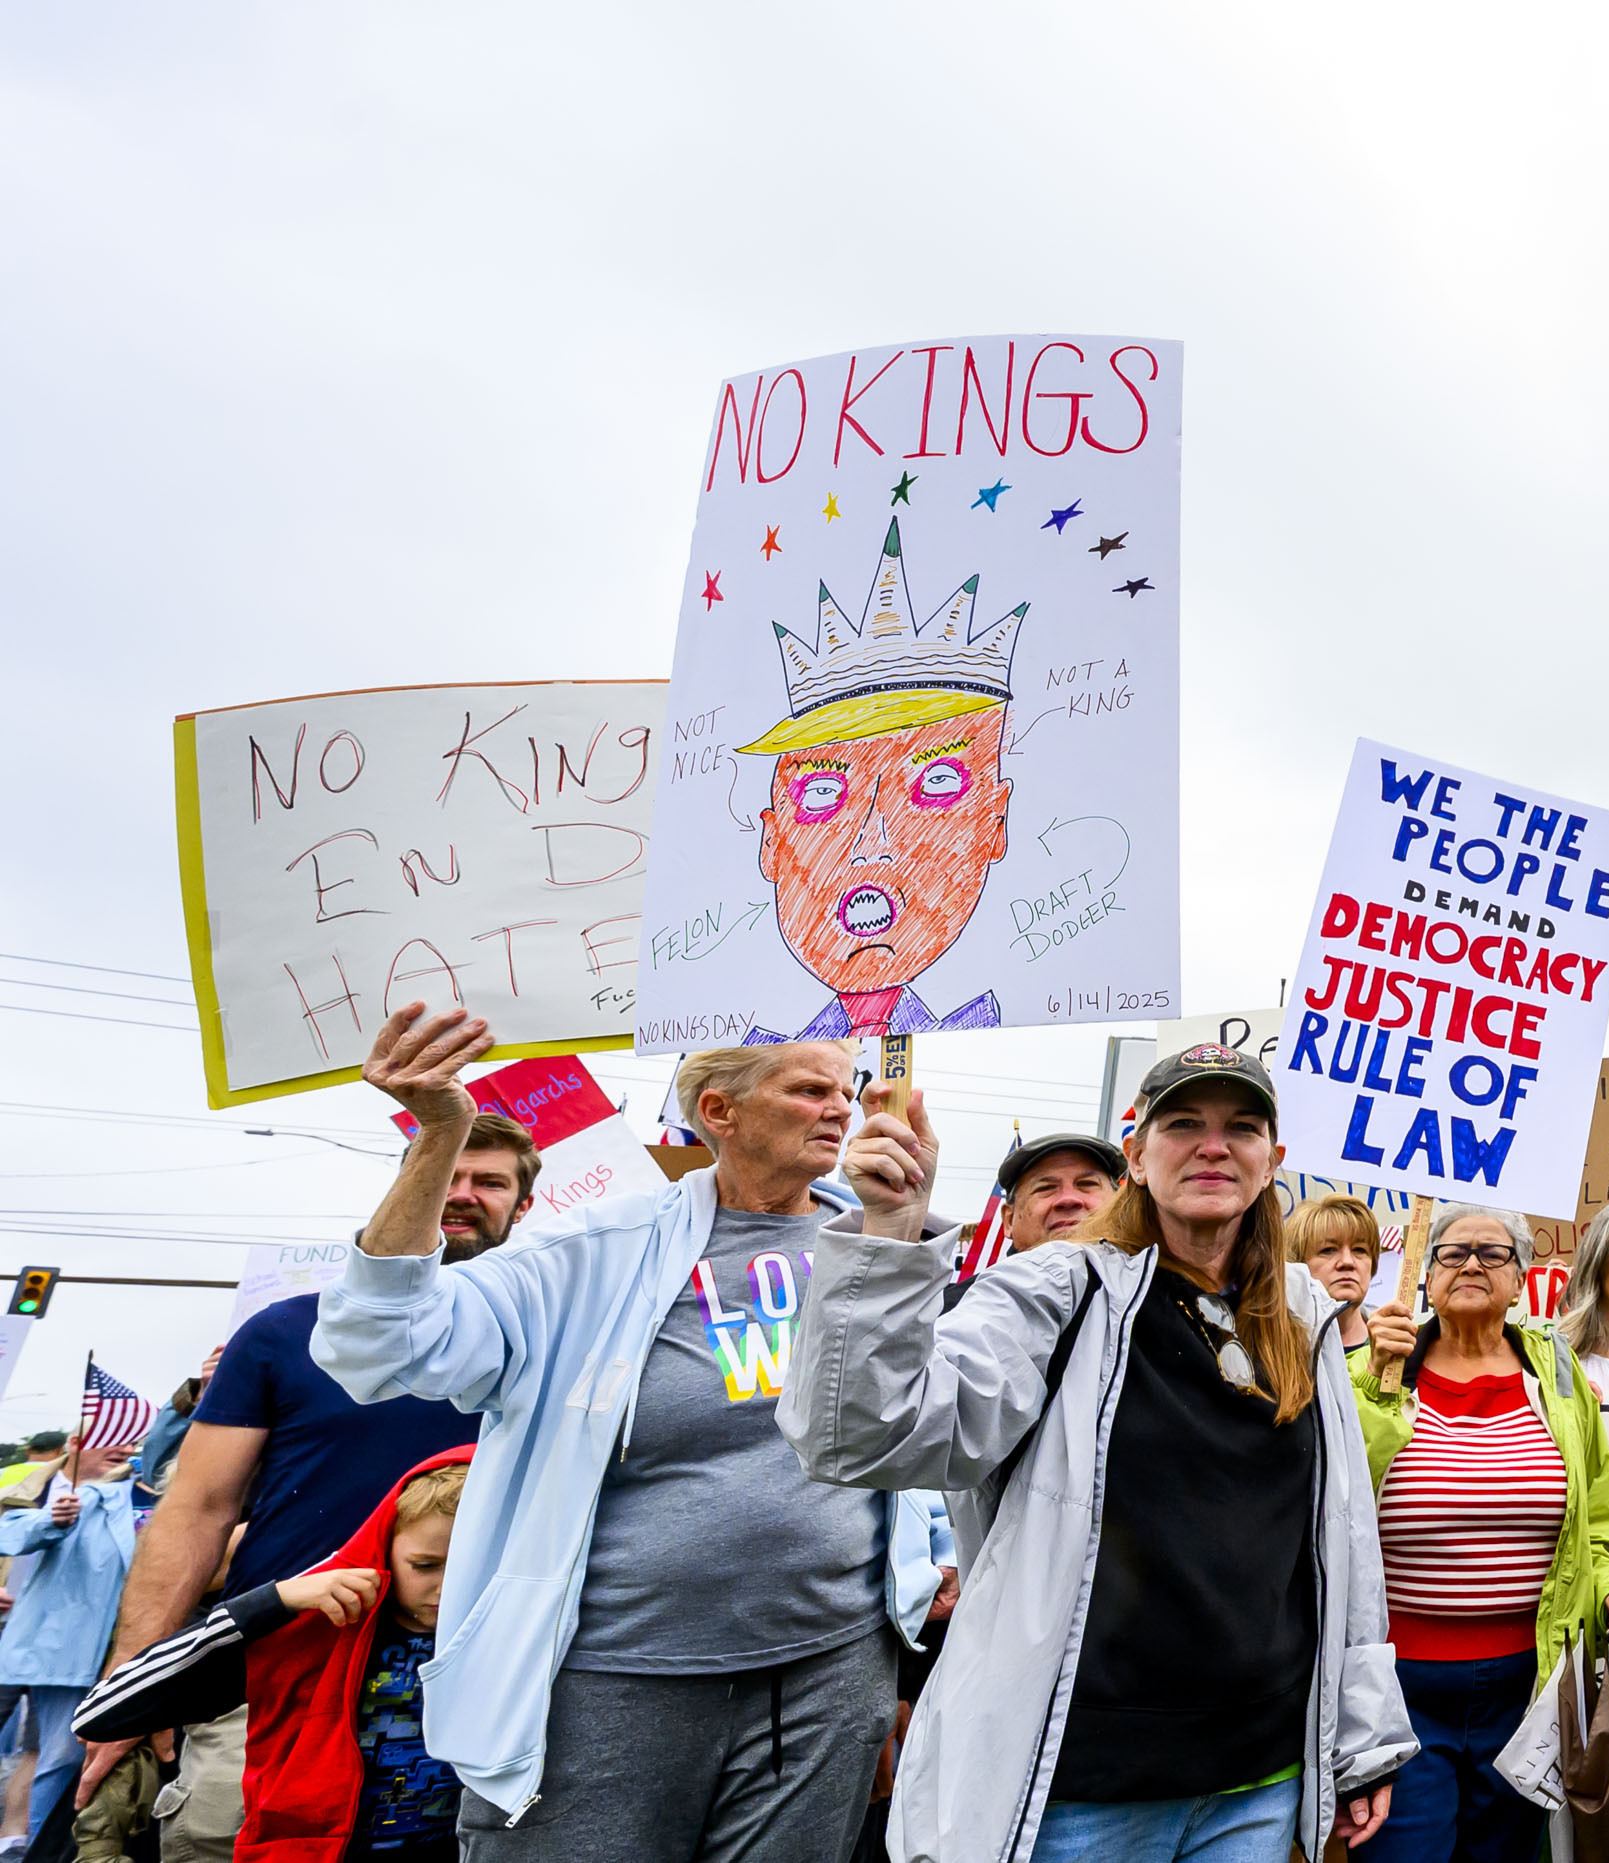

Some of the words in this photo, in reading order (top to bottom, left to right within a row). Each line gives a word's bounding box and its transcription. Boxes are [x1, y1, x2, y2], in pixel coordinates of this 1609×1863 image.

[706, 368, 807, 492] NO
[834, 340, 1159, 469] KINGS
[1046, 659, 1104, 691] NOT
[1115, 658, 1132, 680] A
[1068, 686, 1136, 719] KING
[674, 704, 727, 743] NOT
[249, 721, 366, 825] NO
[671, 741, 724, 785] NICE
[1379, 757, 1462, 822] WE
[1493, 792, 1589, 862] THE
[650, 902, 723, 971] FELON
[1009, 868, 1096, 936] DRAFT
[1009, 890, 1127, 963] DODGER
[1402, 879, 1556, 940] DEMAND
[1319, 892, 1609, 1002] DEMOCRACY
[282, 911, 643, 1063] HATE
[1046, 985, 1171, 1019] 6/14/2025
[1304, 954, 1548, 1061] JUSTICE
[1287, 1009, 1434, 1099] RULE
[1448, 1054, 1540, 1121] OF
[1340, 1093, 1518, 1188] LAW
[539, 1163, 614, 1214] Kings
[279, 1244, 348, 1264] FUND
[691, 1251, 815, 1328] LO
